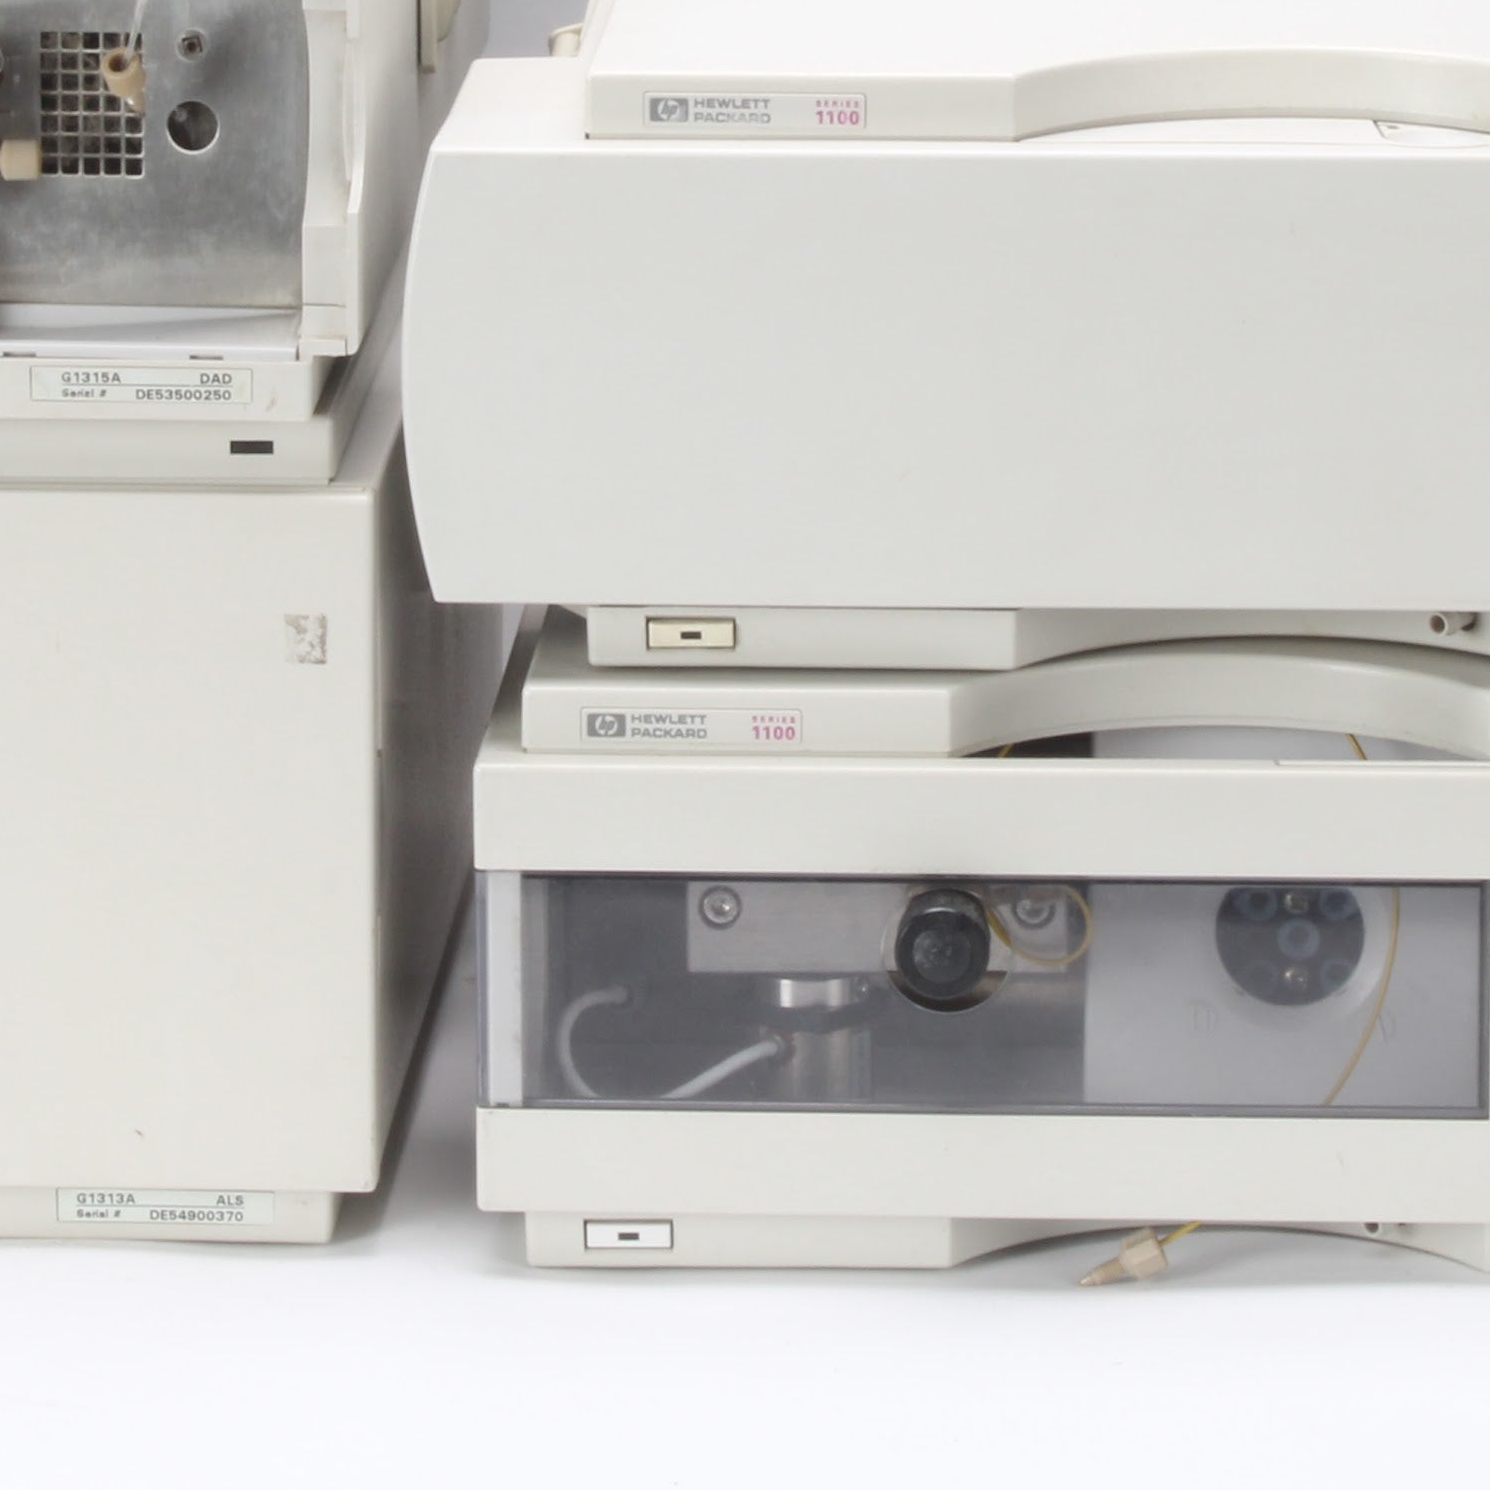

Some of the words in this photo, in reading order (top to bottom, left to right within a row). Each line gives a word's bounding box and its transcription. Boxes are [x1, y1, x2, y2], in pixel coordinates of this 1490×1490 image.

[693, 98, 771, 110] HEWLETT
[815, 99, 860, 109] SERIES
[693, 112, 771, 124] PACKARD
[815, 110, 860, 125] 1100
[61, 371, 121, 384] G1315A
[199, 373, 233, 385] DAD
[61, 388, 94, 398] Serial
[98, 388, 107, 398] #
[135, 388, 232, 401] DE53500250
[630, 714, 707, 725] HEWLETT
[751, 715, 796, 724] SERIES
[630, 727, 708, 740] PACKARD
[751, 725, 796, 740] 1100
[76, 1192, 136, 1205] G1313A
[215, 1194, 244, 1206] ALS
[76, 1208, 109, 1219] Serial
[113, 1209, 121, 1218] #
[149, 1209, 244, 1222] DE54900370
